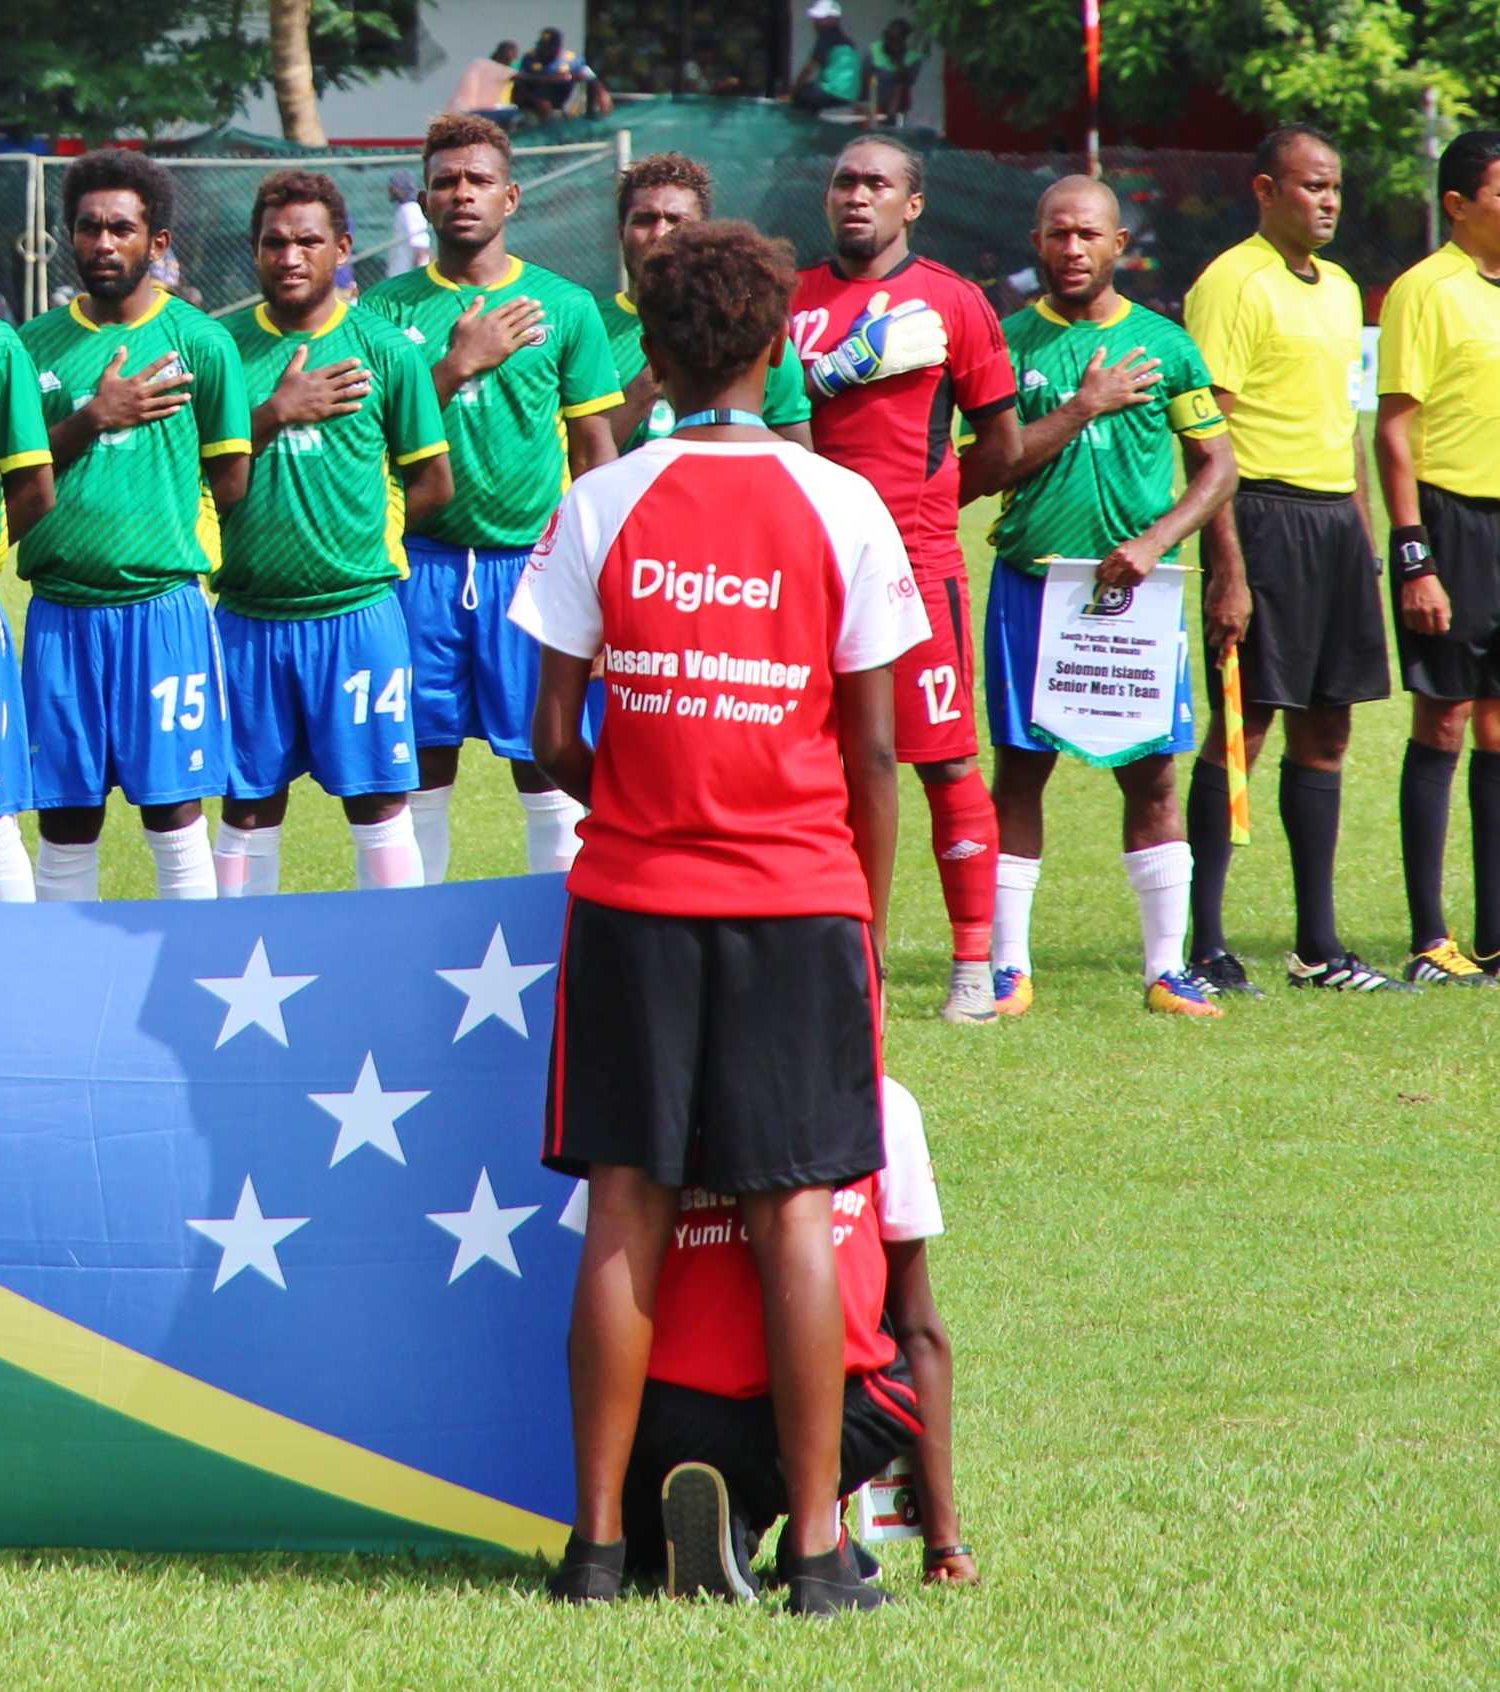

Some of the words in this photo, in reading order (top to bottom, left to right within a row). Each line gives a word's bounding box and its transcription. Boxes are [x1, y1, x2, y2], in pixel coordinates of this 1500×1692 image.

[794, 307, 829, 360] 12
[631, 558, 781, 613] Digicel
[684, 649, 811, 689] Volunteer
[917, 665, 961, 725] 12
[1048, 677, 1088, 693] Senior
[1089, 681, 1125, 697] Men's
[1128, 683, 1160, 699] Team
[1056, 660, 1109, 677] Solomon
[1111, 664, 1156, 681] Islands
[151, 672, 206, 732] 15
[342, 668, 407, 724] 14
[676, 694, 707, 717] on
